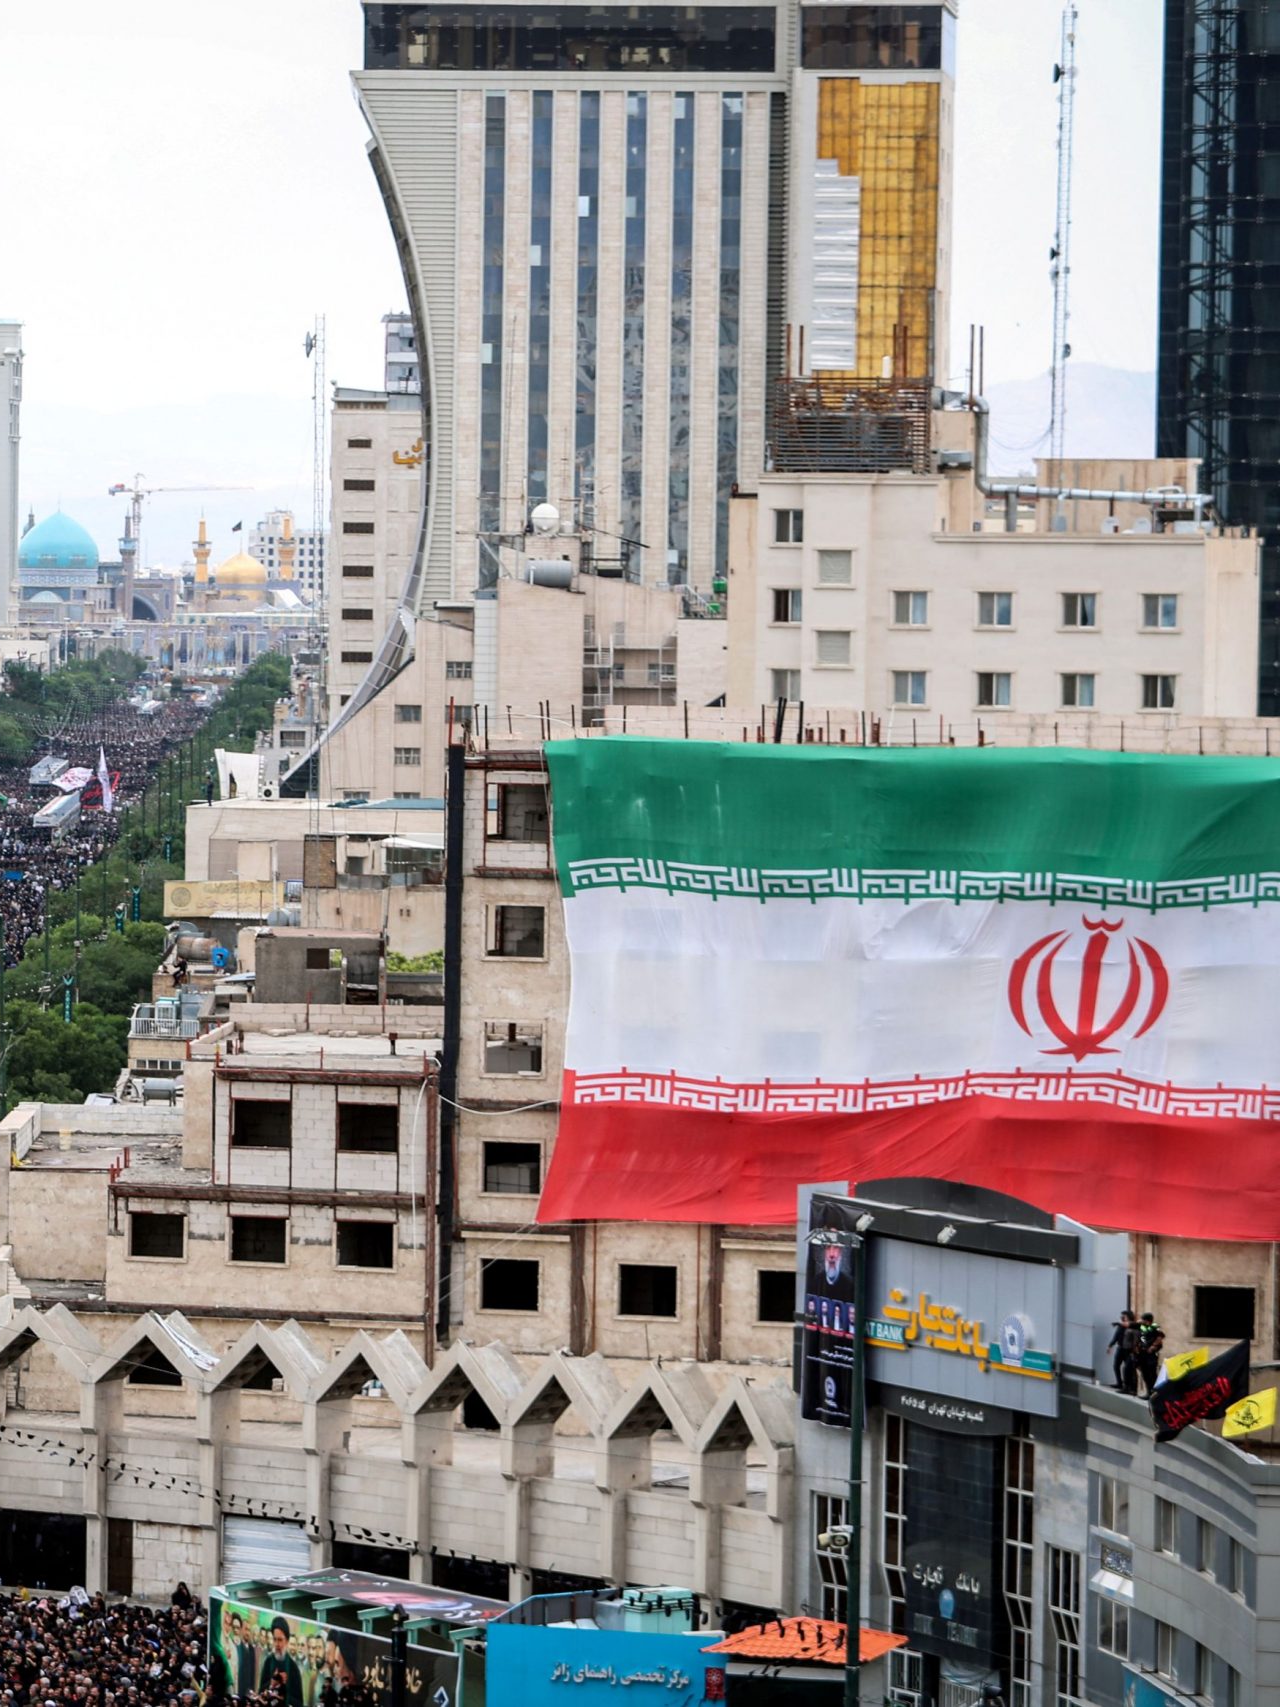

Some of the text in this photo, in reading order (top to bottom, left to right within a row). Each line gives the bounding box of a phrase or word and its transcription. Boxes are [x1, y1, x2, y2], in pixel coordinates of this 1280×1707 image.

[876, 1324, 904, 1343] BANK
[882, 1288, 990, 1374] بانک تجارت
[912, 1563, 980, 1600] بانک تجارت
[551, 1661, 689, 1689] مرکز تخصصی راهنمای زائر
